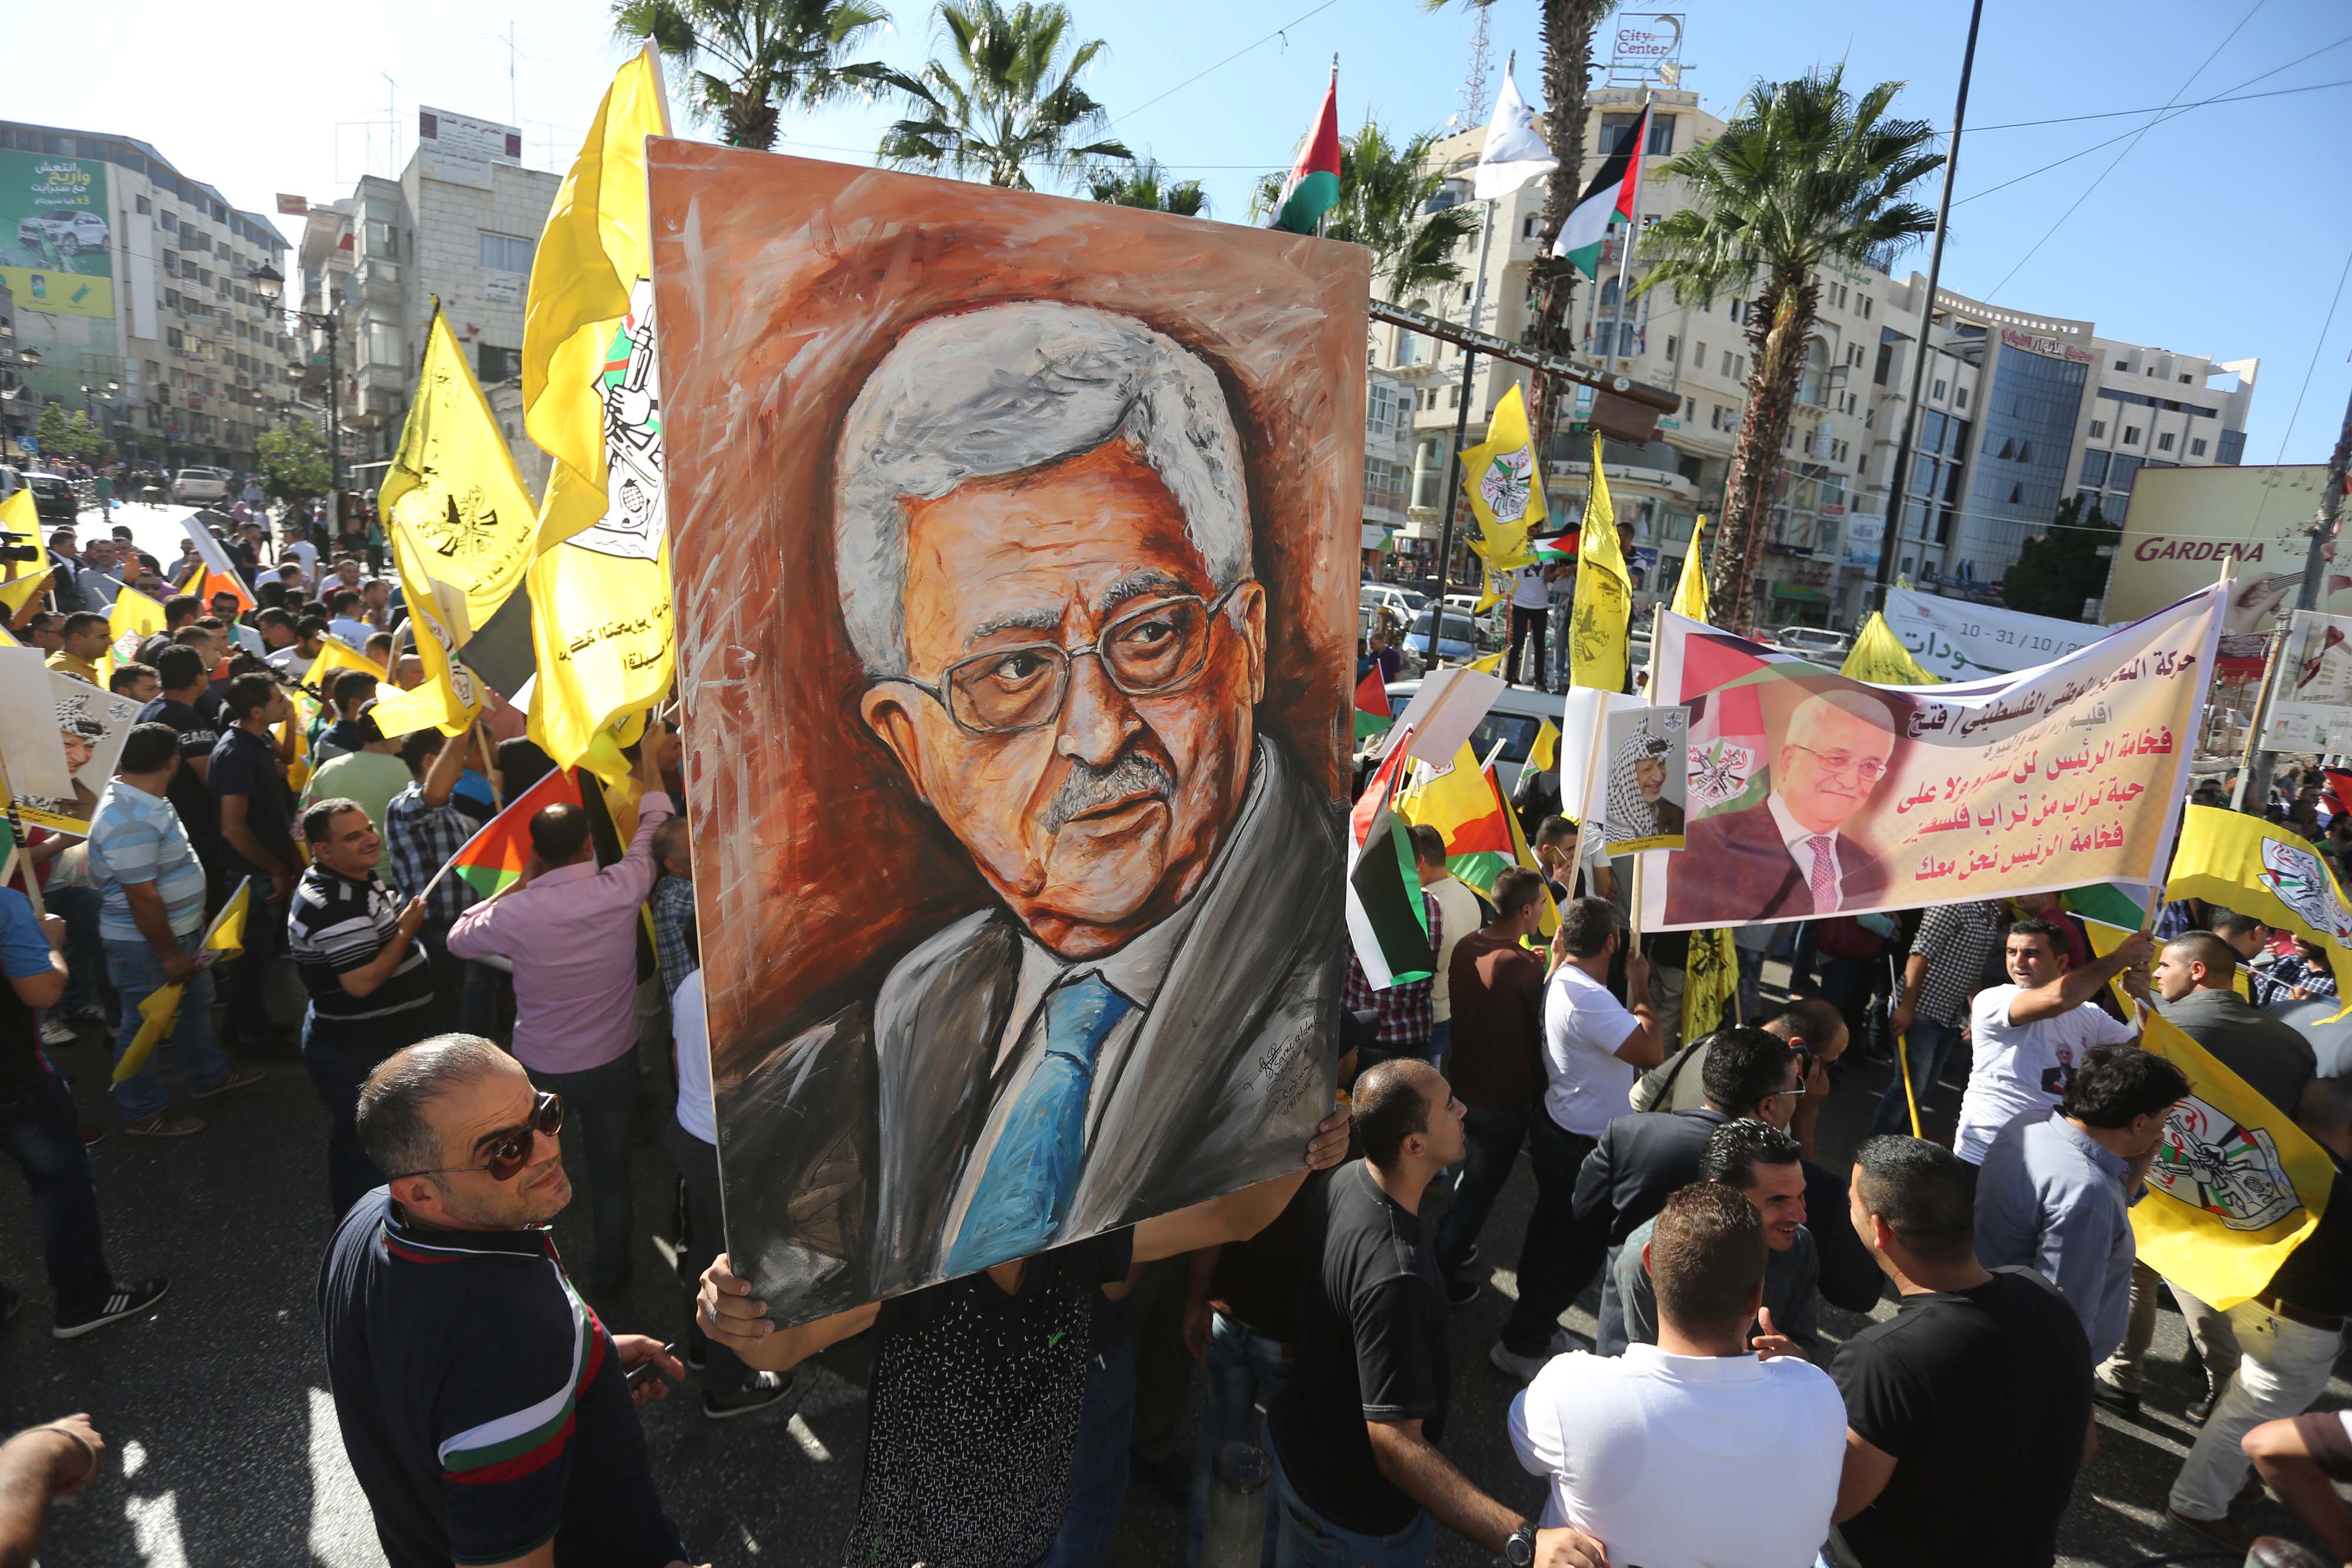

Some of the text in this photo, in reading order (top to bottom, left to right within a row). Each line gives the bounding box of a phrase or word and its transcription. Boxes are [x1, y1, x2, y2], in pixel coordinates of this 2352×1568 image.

[1618, 29, 1651, 43] City
[1618, 42, 1668, 55] Center
[34, 161, 76, 174] انتعش
[1460, 329, 1509, 350] العودة
[1509, 345, 1539, 363] عن
[1541, 356, 1589, 381] بديل
[1591, 369, 1604, 382] لا
[2134, 536, 2265, 563] GARDENA
[1960, 623, 1980, 637] 10
[1996, 630, 2014, 645] 31
[2030, 637, 2051, 651] 10
[2155, 650, 2197, 681] حركة
[1908, 704, 1947, 738] فتح
[1961, 690, 2044, 738] الفلسطيني
[2117, 724, 2173, 758] فخامة
[2013, 750, 2038, 784] لن
[2046, 737, 2115, 780] الرئيس
[1897, 780, 1937, 814] على
[2031, 793, 2058, 827] من
[2062, 780, 2106, 820] تراب
[2106, 776, 2144, 810] حبة
[1977, 794, 2028, 836] تراب
[1915, 820, 2124, 881] فخامة الرئيس نحن معك
